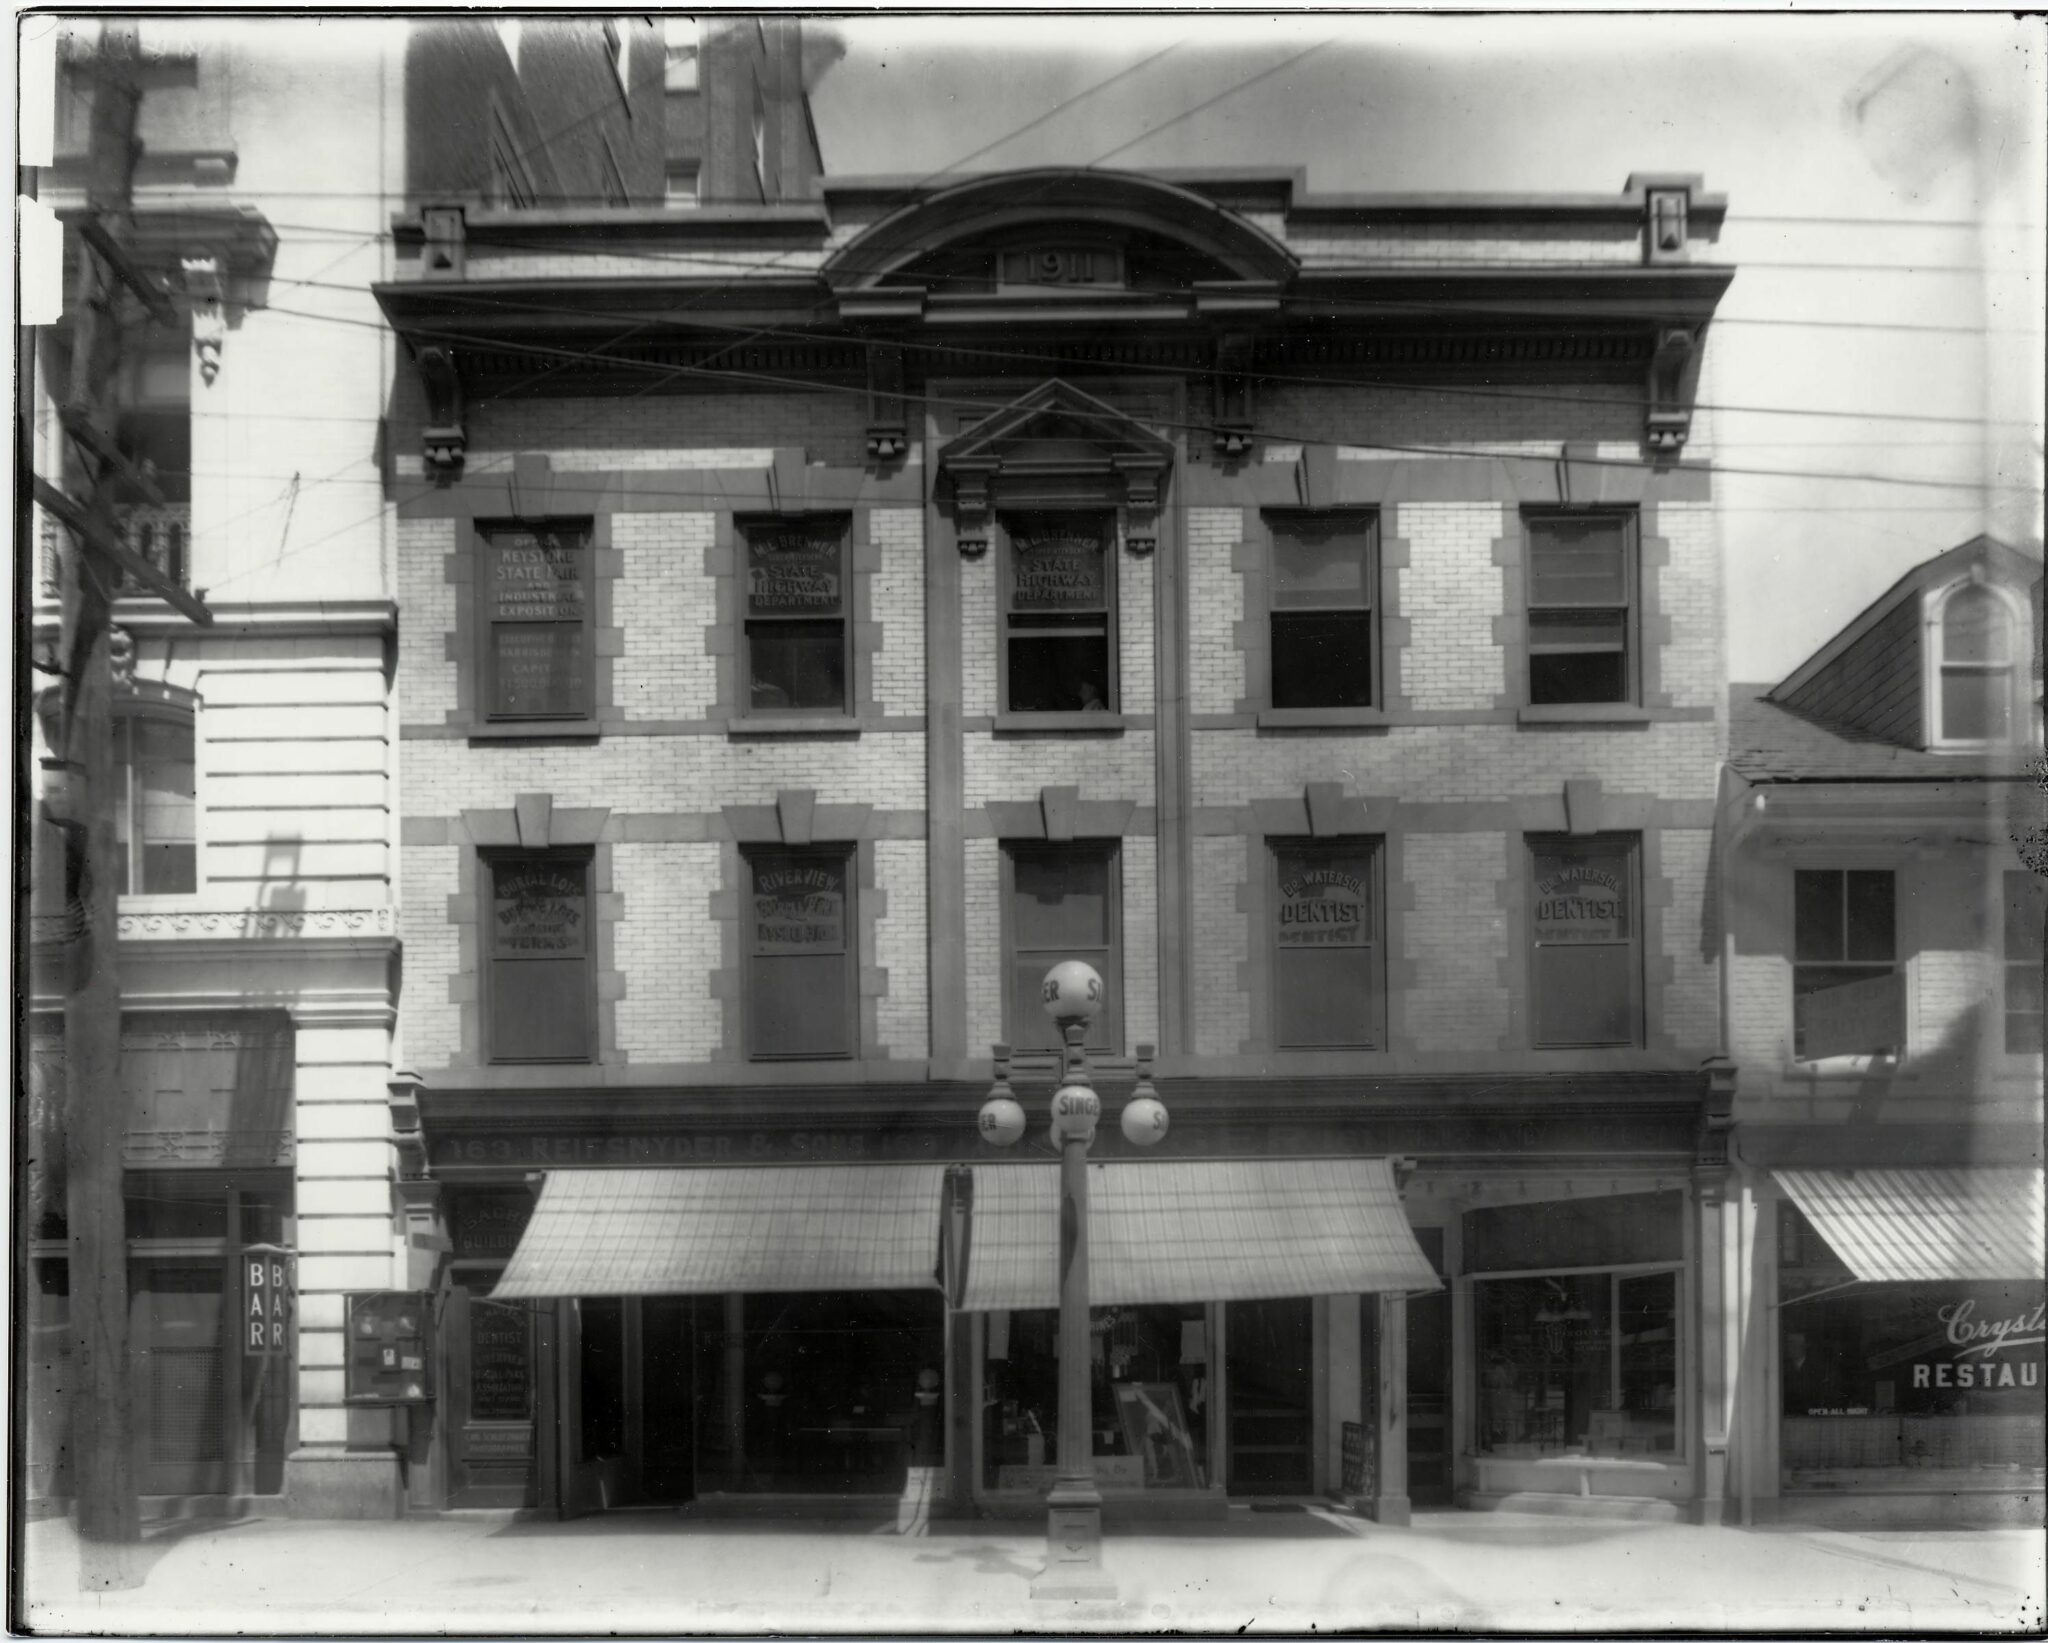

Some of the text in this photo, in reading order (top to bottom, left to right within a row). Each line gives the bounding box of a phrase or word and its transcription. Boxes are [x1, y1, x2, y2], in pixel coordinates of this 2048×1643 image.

[1028, 253, 1095, 282] 1911
[497, 565, 542, 581] STATE
[769, 563, 825, 579] STATE
[1031, 557, 1082, 573] STATE
[754, 579, 836, 594] HIGHWAY
[1016, 573, 1098, 588] HIGHWAY
[754, 595, 838, 608] DEPARTMENT
[1016, 589, 1097, 601] DEPARTMENT
[759, 868, 839, 893] RIVERVIEW
[1281, 902, 1364, 924] DENTIST
[1537, 898, 1625, 920] DENTIST
[530, 1135, 732, 1162] REIFSNYDER
[750, 1133, 773, 1158] &
[789, 1132, 868, 1159] SONS
[249, 1262, 265, 1347] BAR
[271, 1263, 284, 1347] BAR
[1914, 1362, 2038, 1389] RESTAU
[1807, 1407, 1828, 1416] OPEN
[1830, 1407, 1845, 1416] ALL
